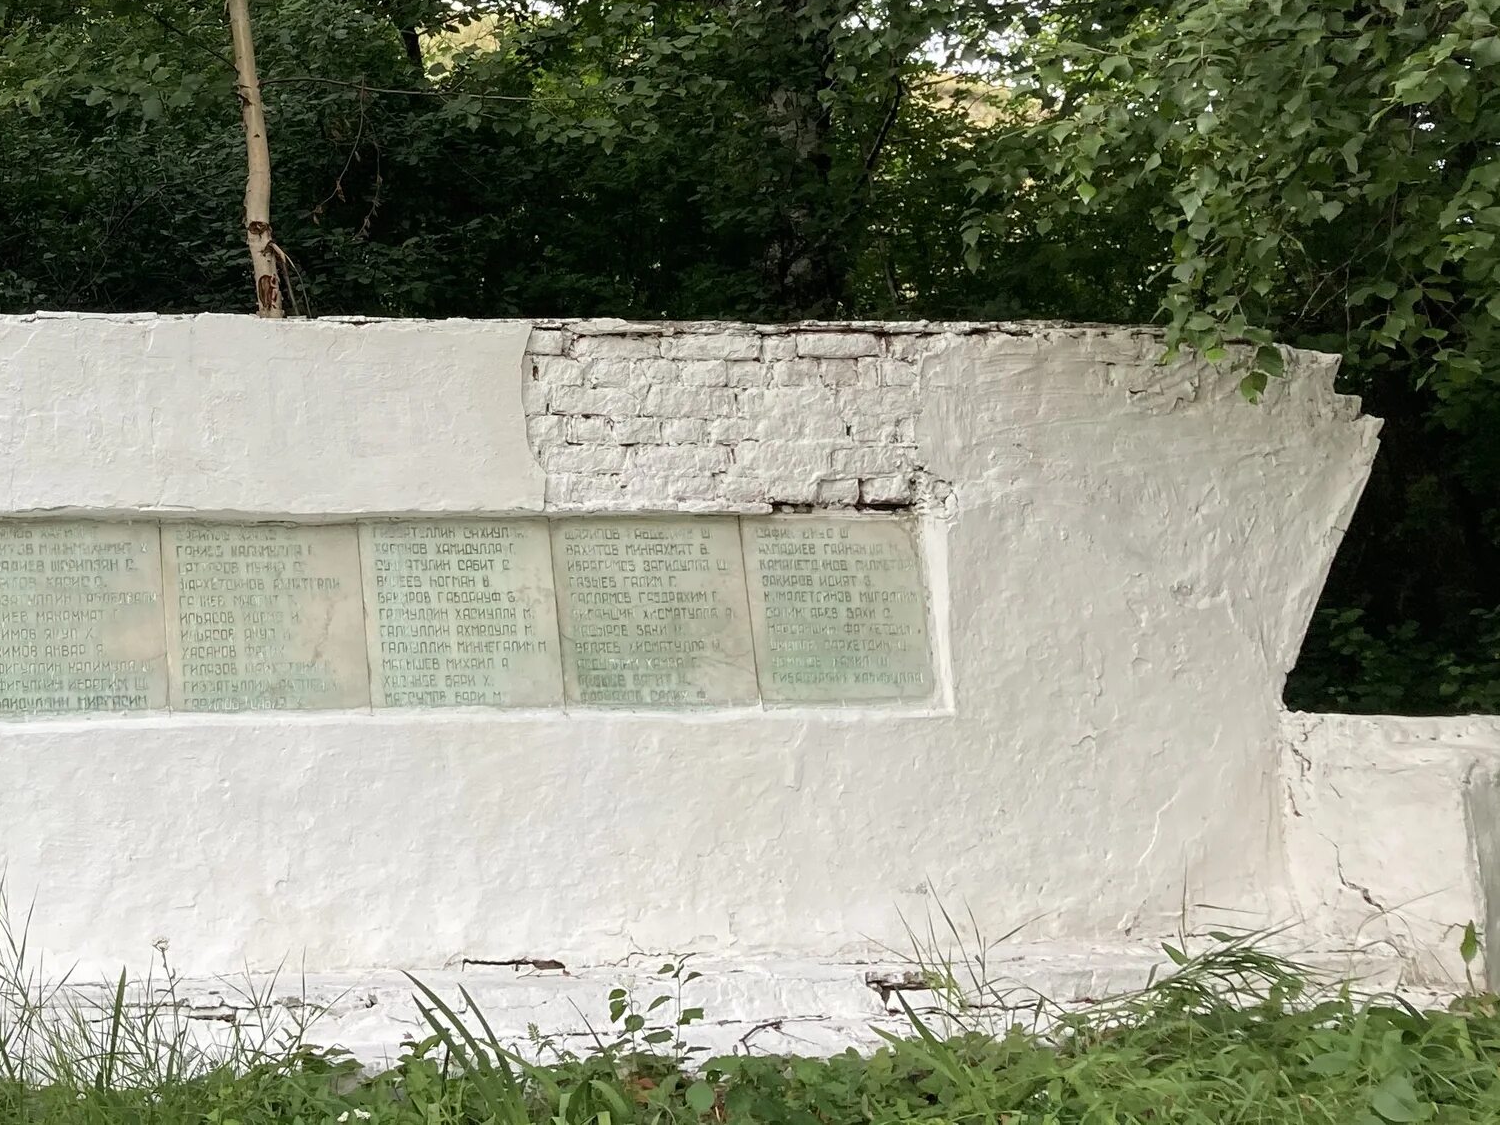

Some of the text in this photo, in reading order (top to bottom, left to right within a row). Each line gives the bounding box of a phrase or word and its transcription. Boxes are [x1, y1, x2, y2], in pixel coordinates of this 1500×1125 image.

[436, 542, 502, 554] ХАМИДУЛЛА
[458, 559, 495, 571] САБИТ
[623, 576, 662, 588] ГАЛИМ
[762, 575, 812, 587] ЗАКИРОВ
[180, 611, 234, 624] ИЛЬЯСОВ
[181, 644, 236, 659] ХАСАНОВ
[446, 657, 494, 671] МИХАИЛ
